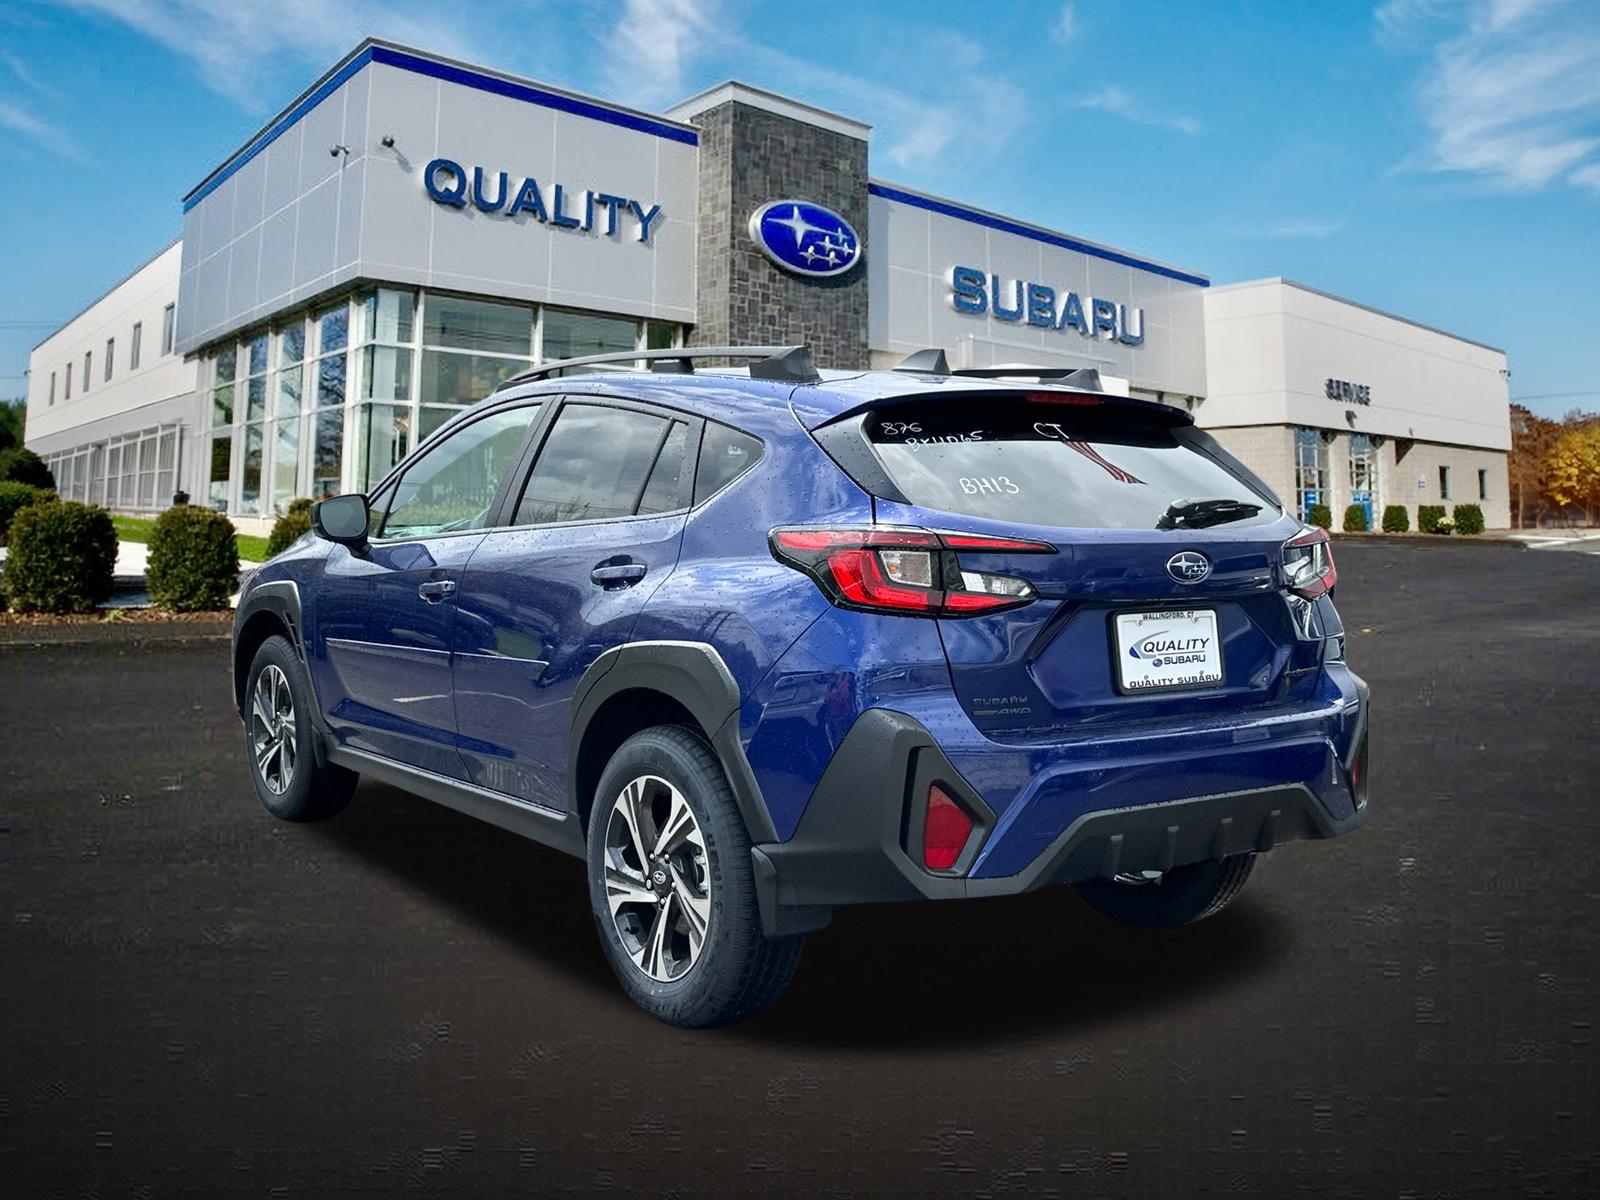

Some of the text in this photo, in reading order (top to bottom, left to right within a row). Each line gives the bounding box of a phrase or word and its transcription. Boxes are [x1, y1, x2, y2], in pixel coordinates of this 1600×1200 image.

[424, 158, 662, 243] QUALITY
[951, 265, 1145, 347] SUBARU
[1325, 378, 1371, 406] SERVICE
[1033, 422, 1070, 439] CT
[1143, 638, 1210, 653] QUALITY
[1163, 654, 1206, 665] SUBARU
[1129, 674, 1219, 688] QUALITY SUBARU
